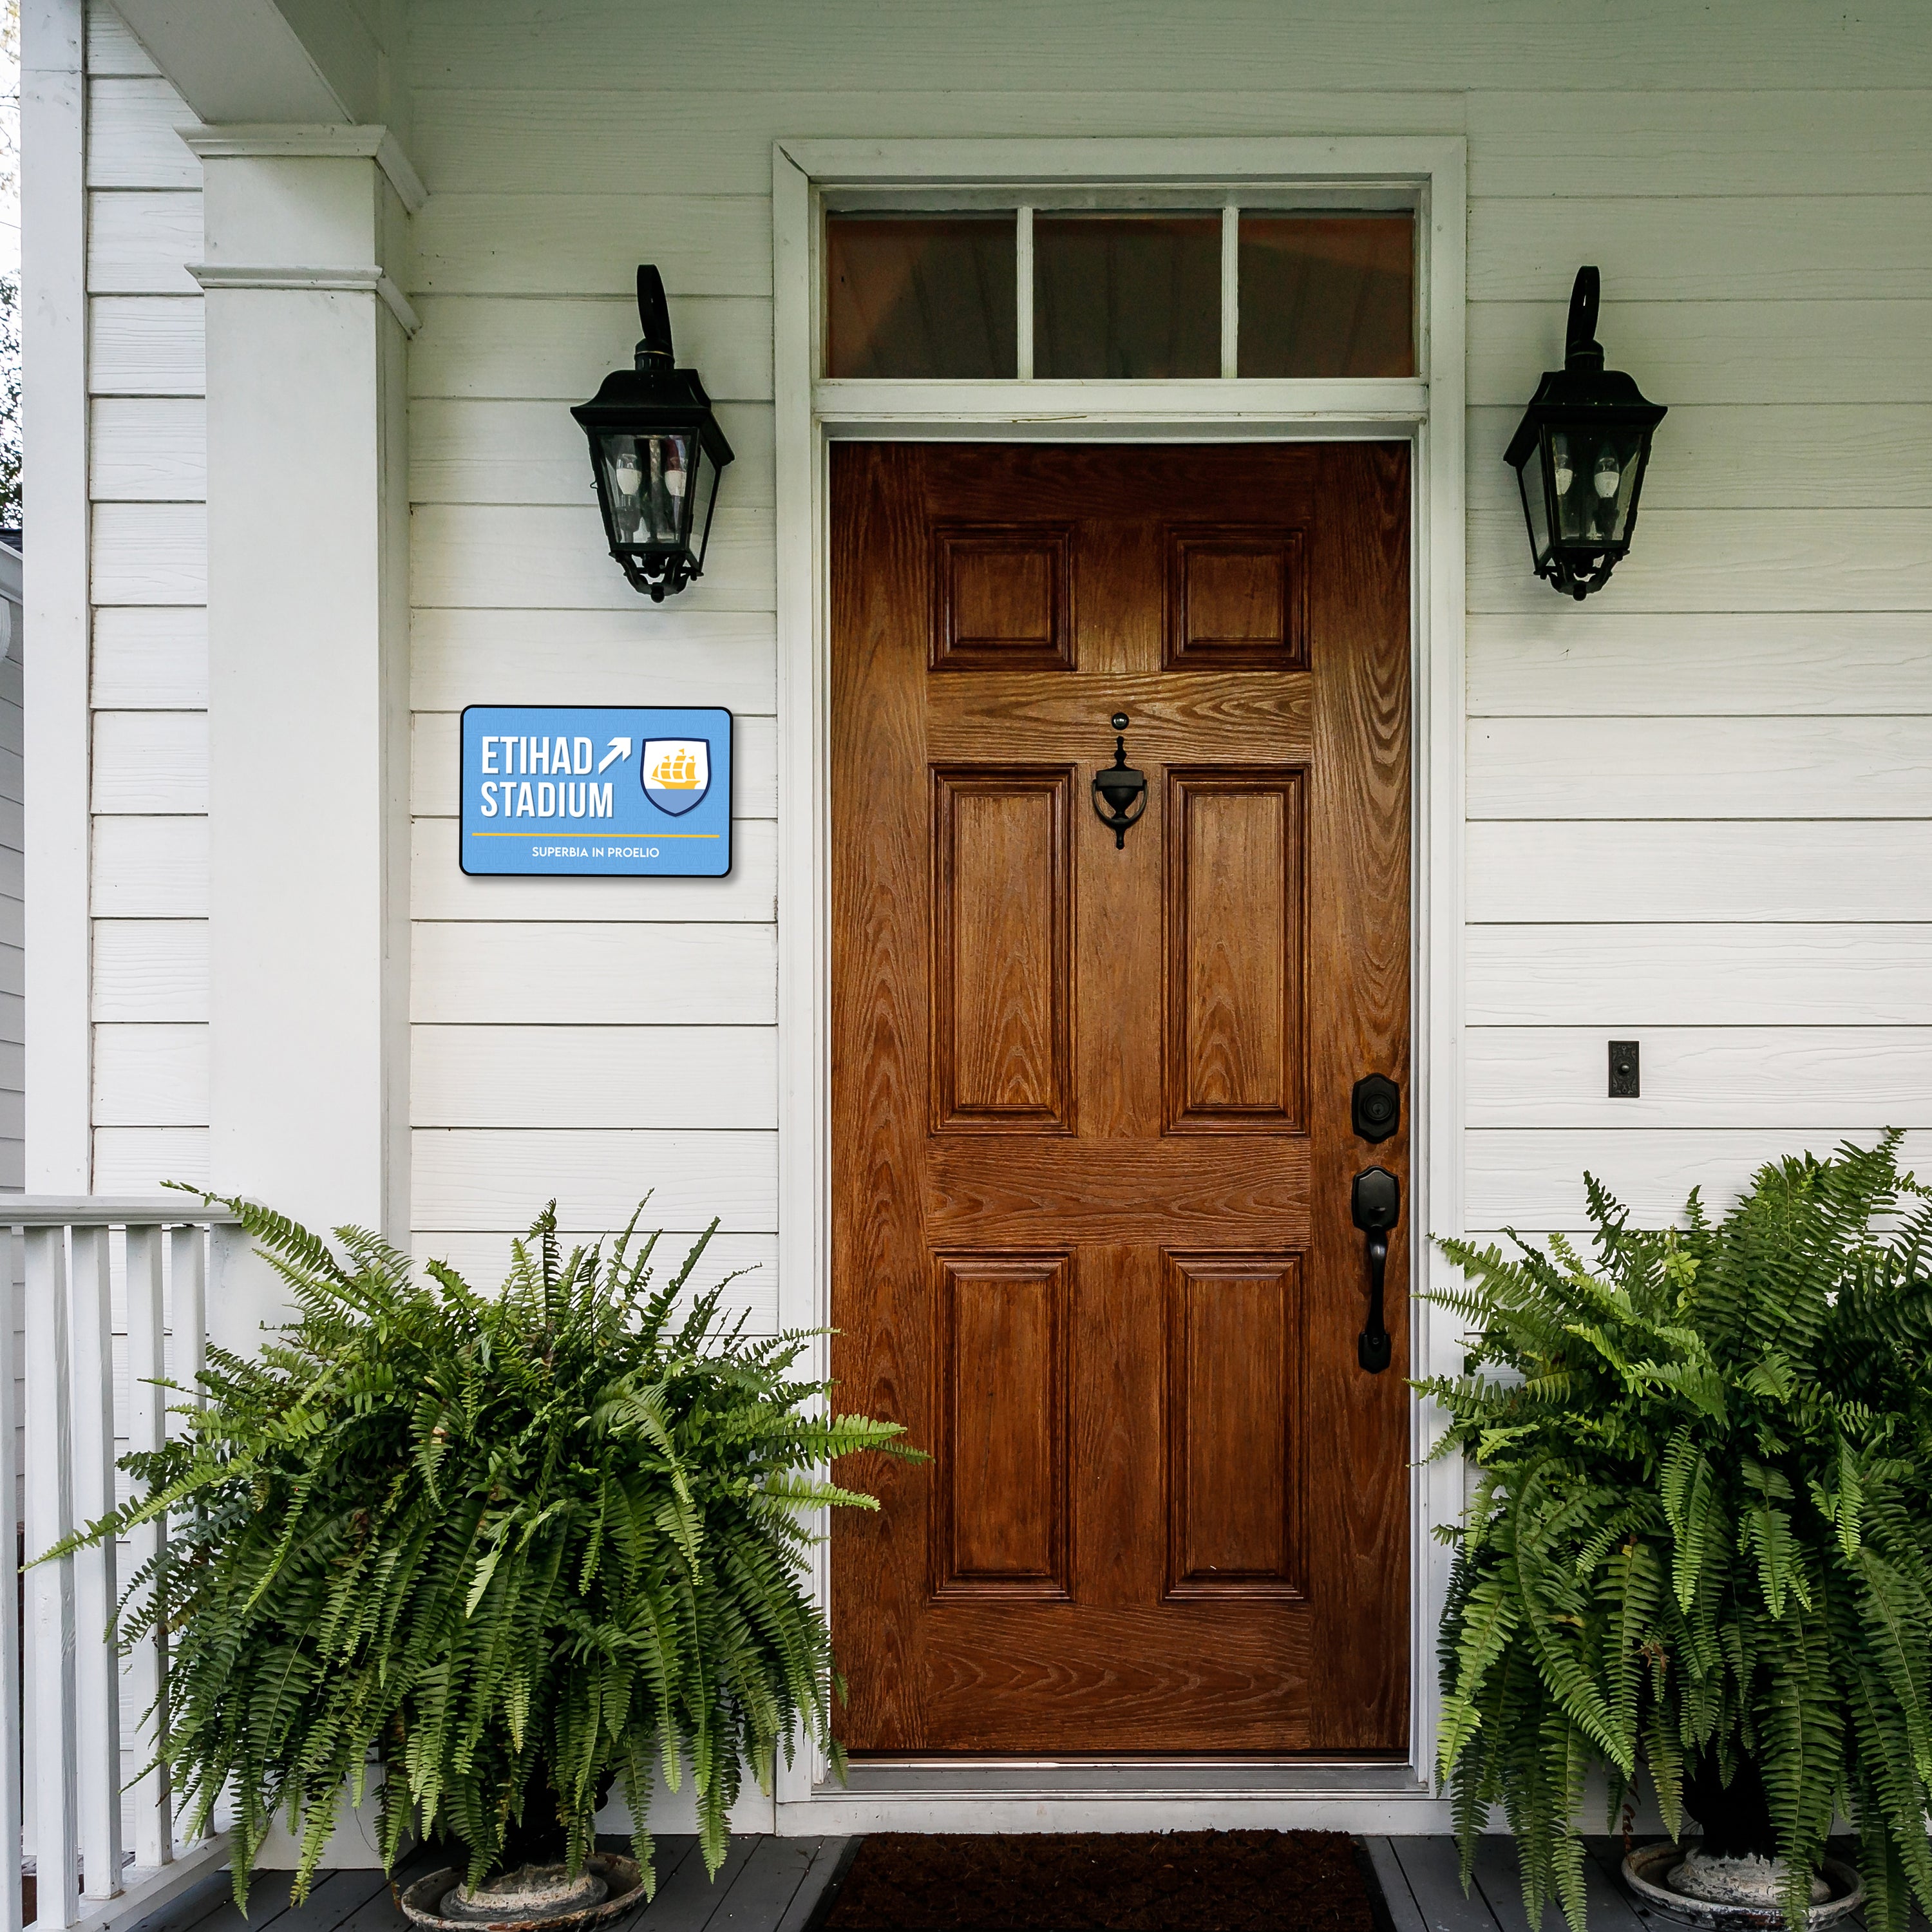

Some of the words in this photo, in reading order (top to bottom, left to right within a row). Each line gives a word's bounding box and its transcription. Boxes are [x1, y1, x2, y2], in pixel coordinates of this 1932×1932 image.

[482, 736, 592, 774] ETIHAD
[480, 781, 613, 817] STADIUM
[532, 846, 589, 857] SUPERBIA
[592, 847, 604, 857] IN
[607, 847, 659, 858] PROELIO
